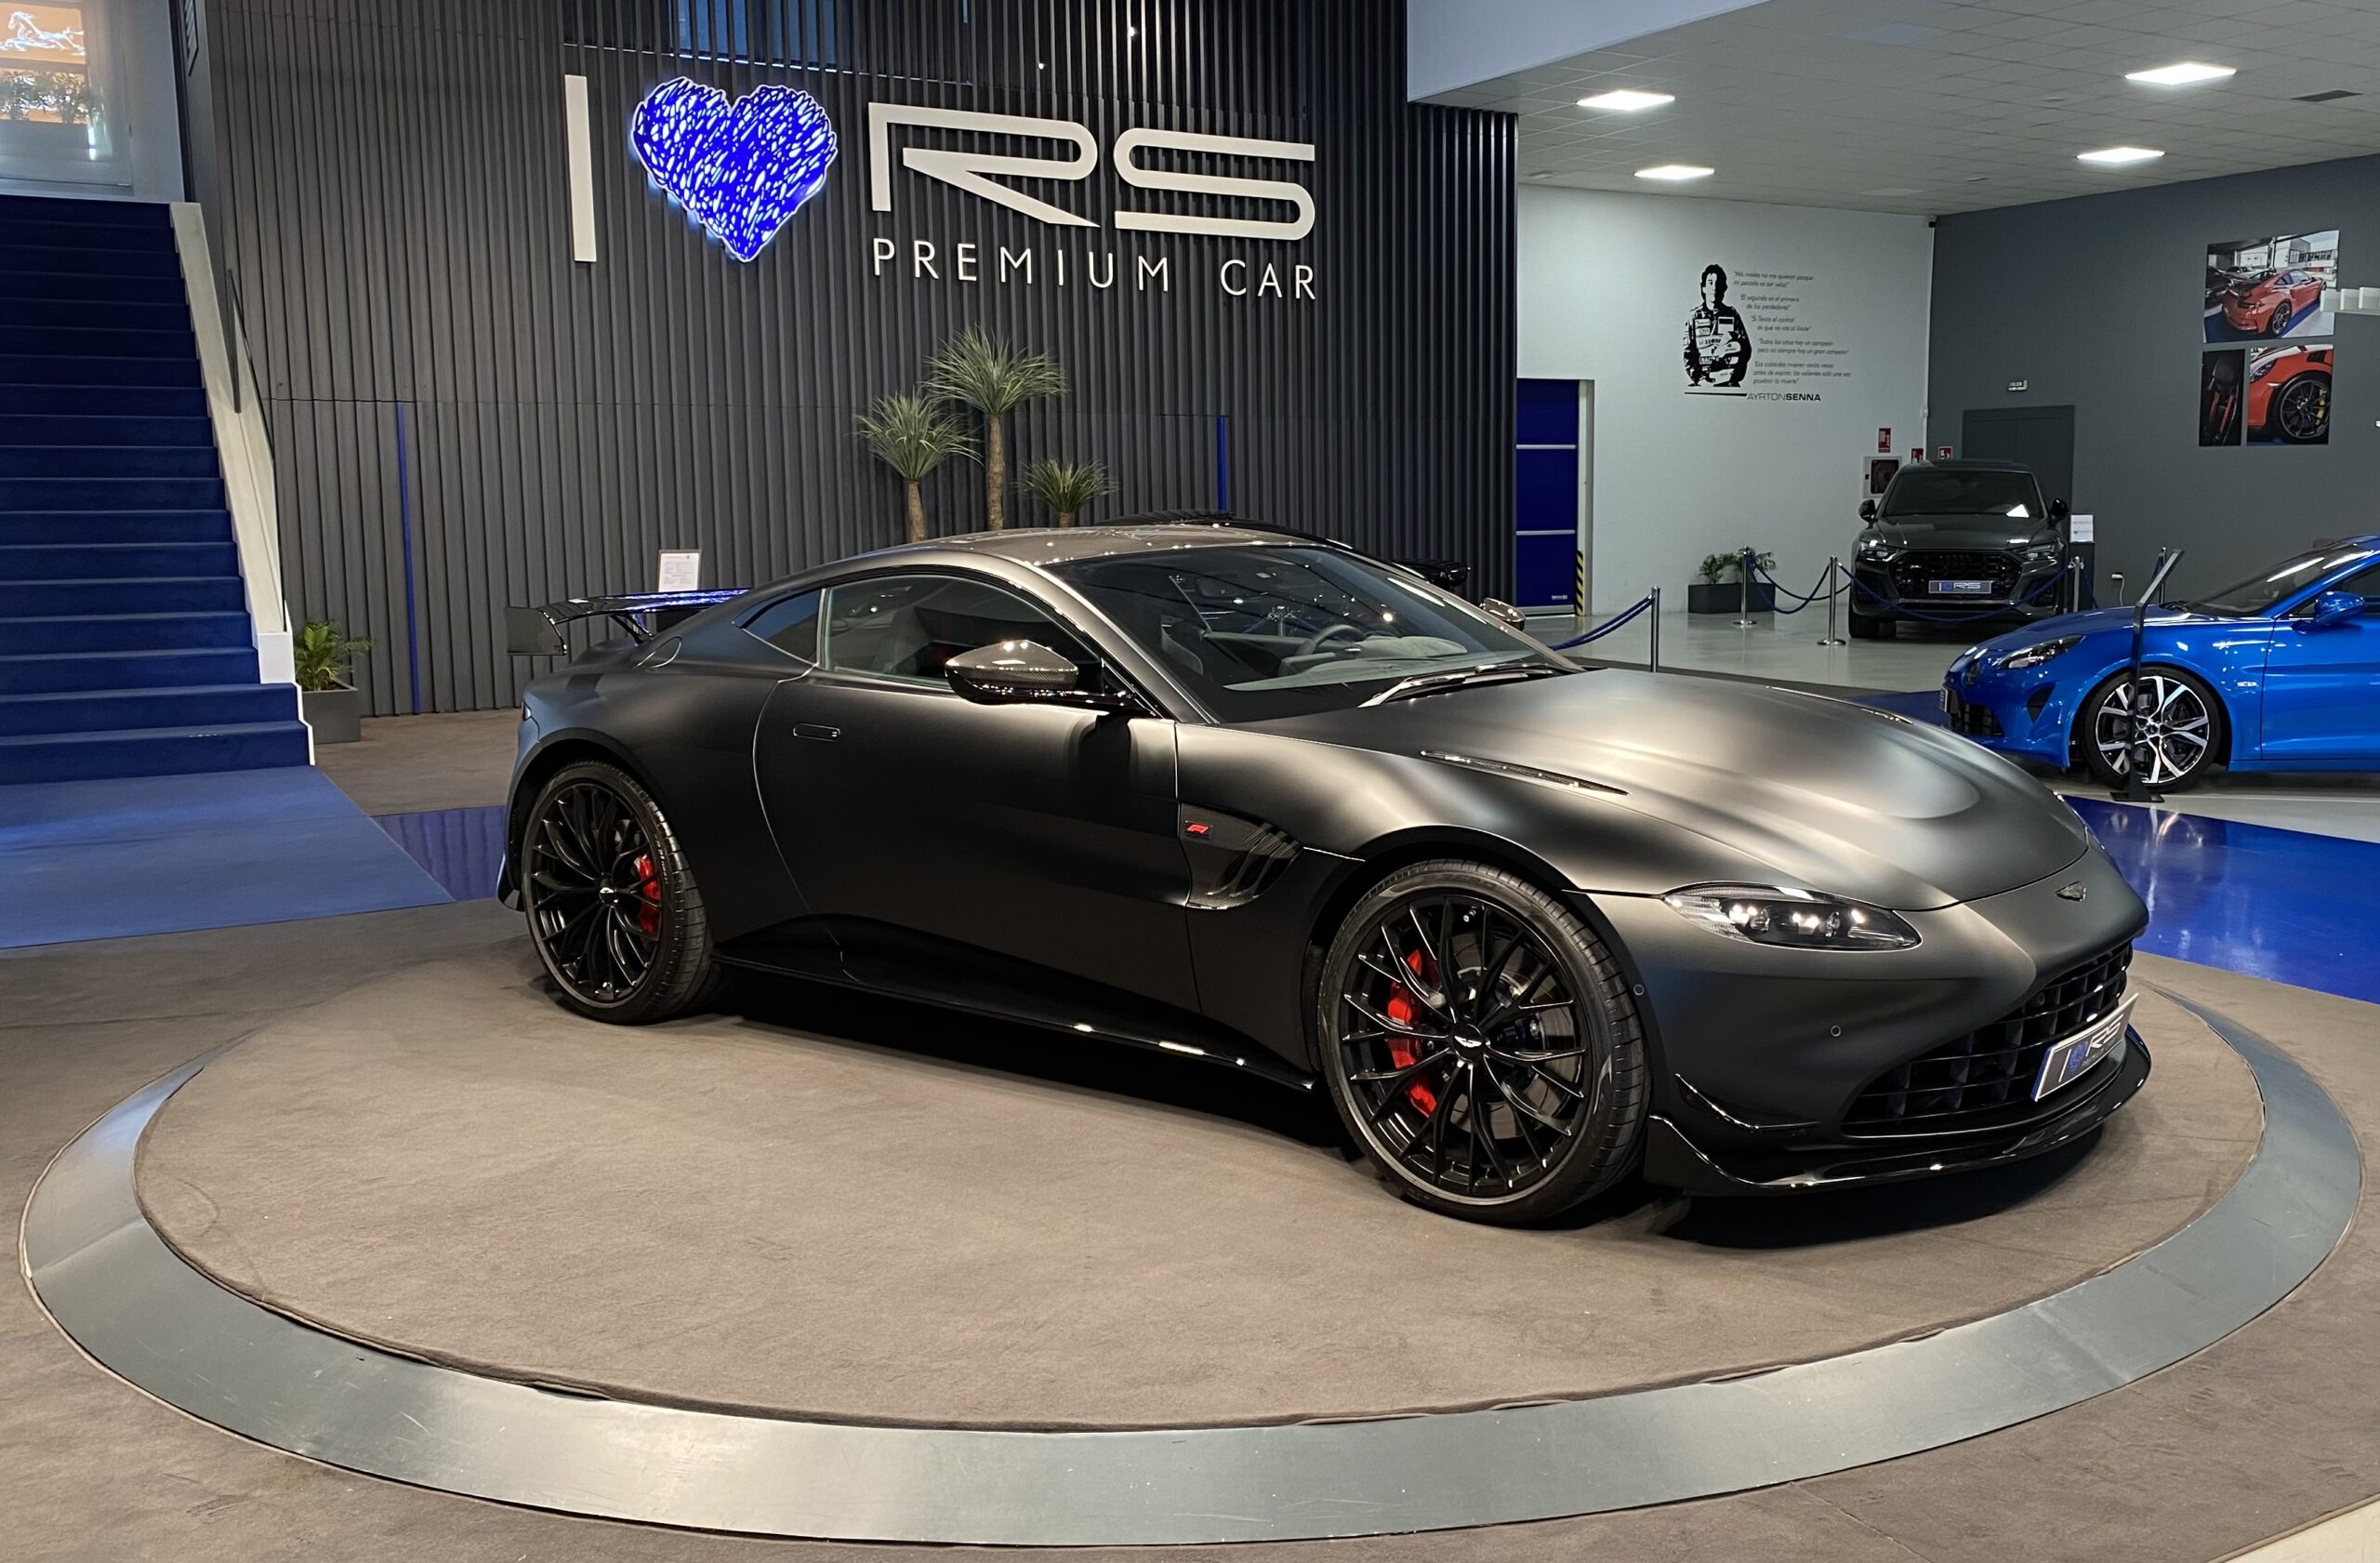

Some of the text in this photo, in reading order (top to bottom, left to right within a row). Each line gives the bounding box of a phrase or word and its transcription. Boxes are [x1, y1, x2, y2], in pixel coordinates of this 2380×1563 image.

[868, 101, 1316, 242] RS
[873, 237, 1316, 300] PREMIUM CAR
